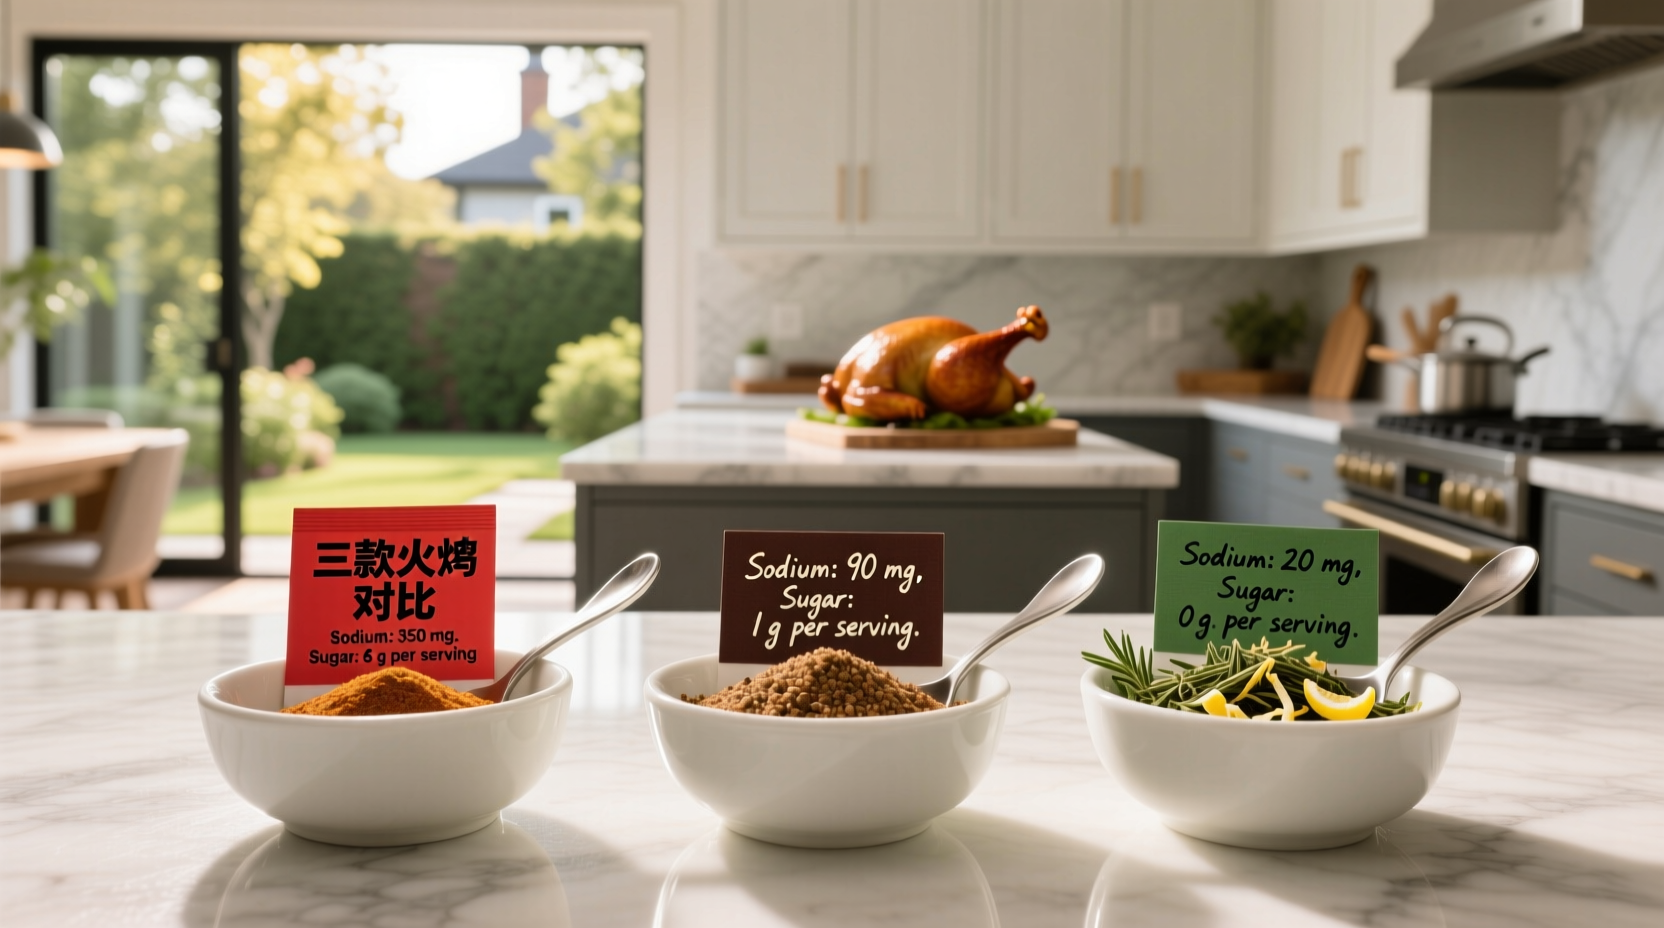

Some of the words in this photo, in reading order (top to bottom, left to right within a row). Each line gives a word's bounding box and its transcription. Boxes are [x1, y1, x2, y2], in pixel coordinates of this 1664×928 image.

[745, 551, 838, 580] Sodium:
[847, 552, 877, 581] 90
[884, 564, 923, 594] mg,
[1179, 541, 1274, 569] Sodium:
[1280, 548, 1315, 572] 20
[1321, 557, 1361, 586] mg,
[352, 581, 436, 622] 对比
[780, 584, 854, 620] Sugar:
[1217, 575, 1295, 612] Sugar:
[330, 629, 394, 645] Sodium:
[397, 628, 427, 644] 350
[430, 629, 460, 646] mg.
[752, 611, 763, 637] 1
[764, 621, 782, 650] g
[789, 620, 829, 647] per
[834, 614, 920, 651] serving.
[1178, 604, 1195, 628] 0
[1222, 613, 1262, 640] per
[1269, 613, 1359, 649] serving.
[309, 649, 359, 667] Sugar:
[363, 648, 373, 663] 6
[377, 651, 386, 667] g
[390, 650, 416, 666] per
[420, 646, 477, 664] serving
